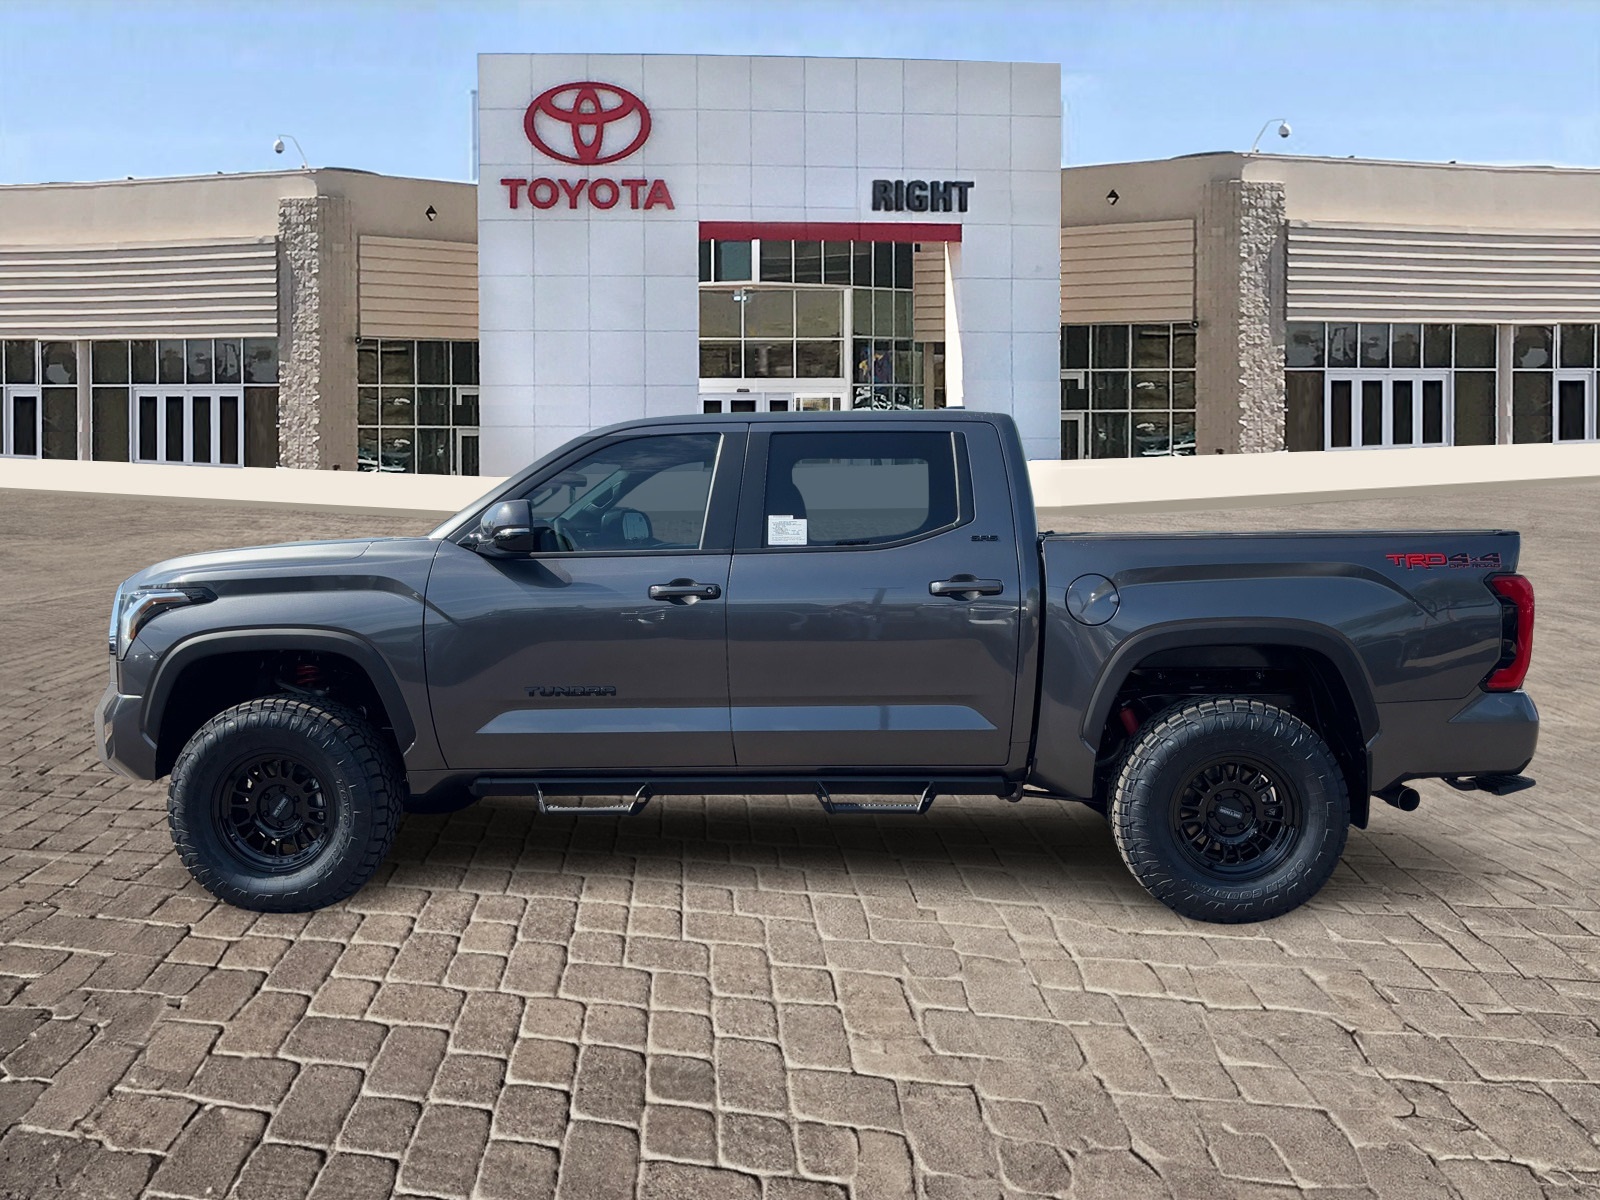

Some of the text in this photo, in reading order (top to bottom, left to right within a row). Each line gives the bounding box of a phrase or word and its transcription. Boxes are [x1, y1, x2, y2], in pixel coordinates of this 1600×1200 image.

[500, 177, 675, 210] TOYOTA
[872, 179, 975, 212] RIGHT
[1385, 553, 1448, 570] TRD
[523, 685, 617, 697] TUNDRA
[1266, 858, 1306, 894] OPEN
